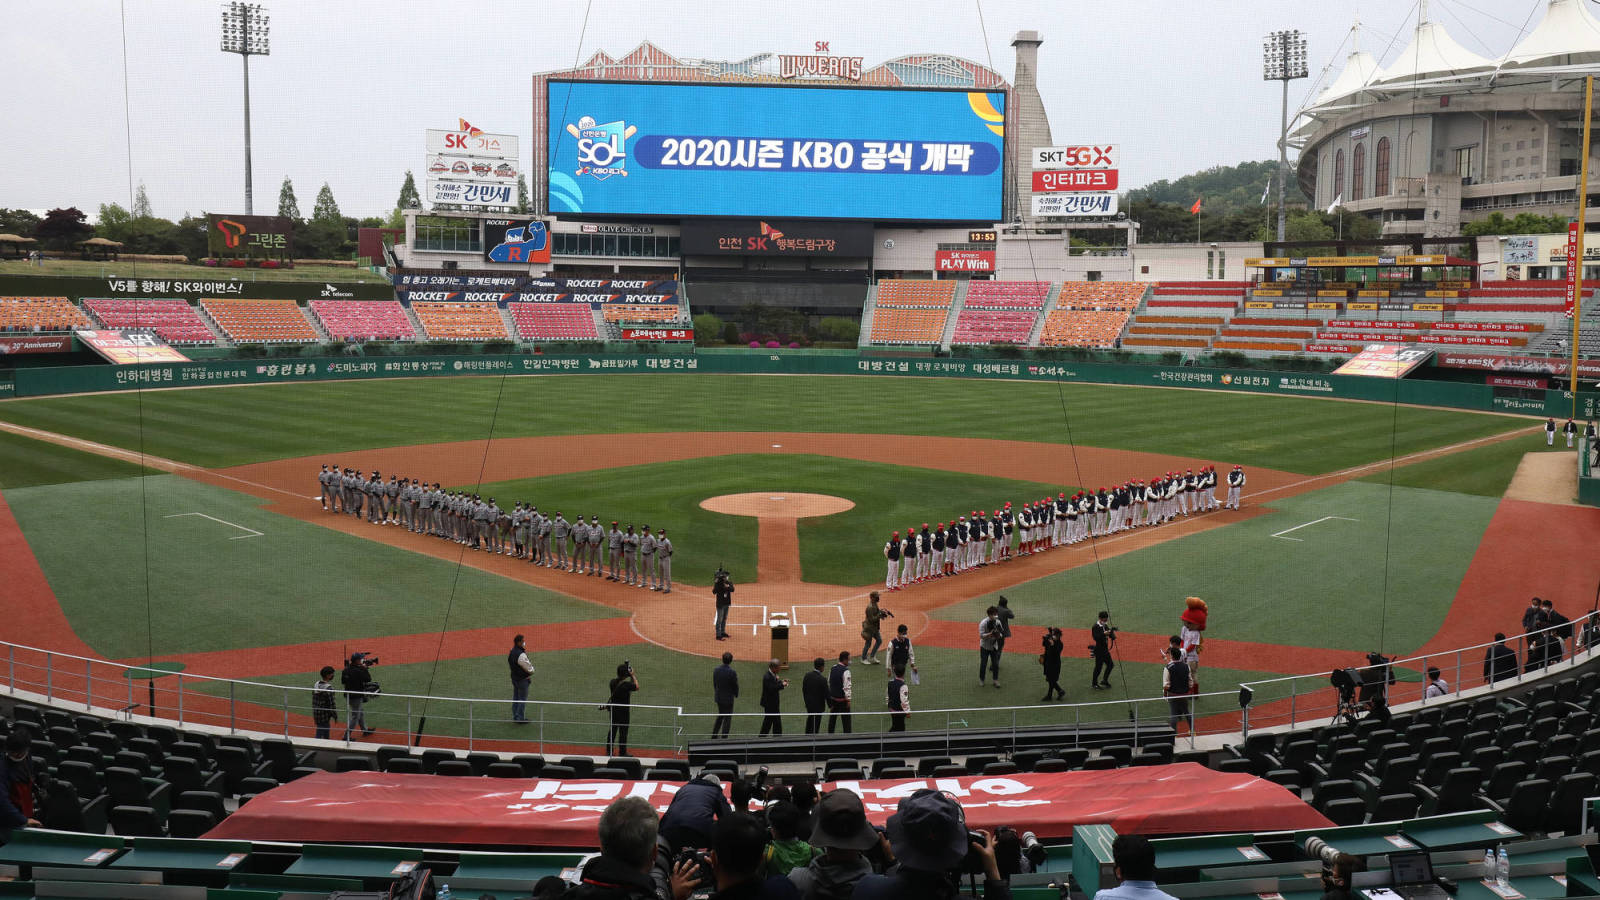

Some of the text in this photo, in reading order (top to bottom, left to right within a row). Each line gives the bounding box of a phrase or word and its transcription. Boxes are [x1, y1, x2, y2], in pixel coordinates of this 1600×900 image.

[815, 41, 830, 52] SK
[778, 55, 864, 81] WYVERNS
[445, 133, 501, 150] SK 가스
[660, 138, 974, 172] 2020시즌 KBO 공식 개막
[1039, 145, 1113, 167] SKT 5GX
[1042, 172, 1108, 190] 인터파크
[463, 184, 511, 203] 간만세
[1064, 196, 1112, 213] 간만세
[598, 225, 620, 233] OLIVE
[620, 225, 652, 233] CHICKEN
[248, 233, 287, 249] 그린존
[718, 237, 836, 252] 인천 SK 행복드림구장
[507, 246, 522, 261] R
[941, 259, 990, 269] PLAY With
[141, 281, 170, 293] 향해!
[174, 282, 243, 294] SK와이번스!
[566, 279, 602, 288] ROCKET
[611, 280, 647, 289] ROCKET
[408, 291, 448, 301] ROCKET
[464, 292, 504, 302] ROCKET
[519, 293, 558, 302] ROCKET
[572, 294, 612, 303] ROCKET
[625, 294, 664, 303] ROCKET
[24, 341, 63, 349] Anniversary
[335, 362, 376, 373] 도미노피자
[522, 359, 579, 369] 한길안과병원
[646, 358, 698, 369] 대방건설
[858, 360, 909, 371] 대방건설
[1482, 358, 1495, 368] SK
[116, 368, 173, 384] 인하대병원
[182, 370, 247, 380] 인하공업전문대학
[1160, 372, 1213, 383] 한국건강관리협회
[1234, 376, 1270, 387] 신일전자
[1527, 378, 1538, 387] SK
